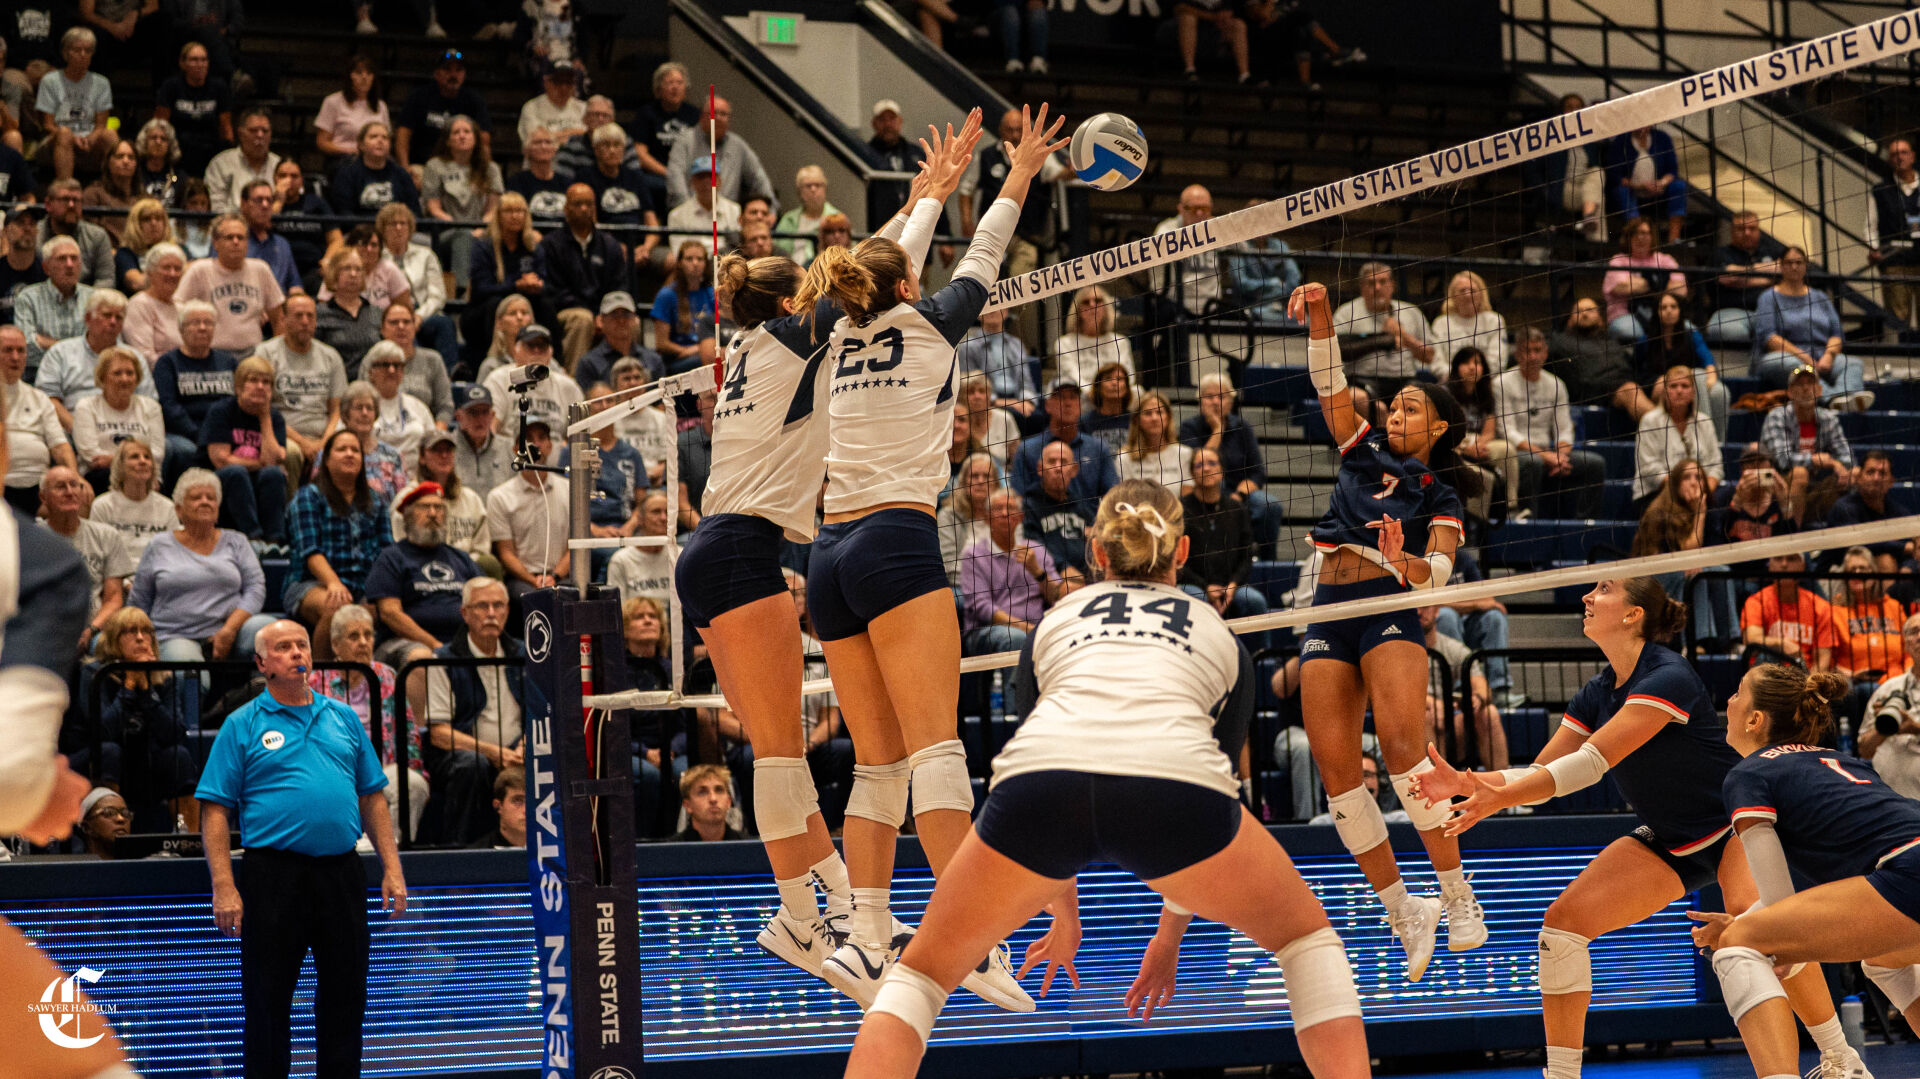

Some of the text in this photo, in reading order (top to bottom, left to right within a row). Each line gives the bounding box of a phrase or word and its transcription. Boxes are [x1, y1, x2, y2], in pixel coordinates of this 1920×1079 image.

[1680, 60, 1759, 107] PENN
[1768, 31, 1860, 81] STATE
[1285, 111, 1593, 221] PENN STATE VOLLEYBALL
[988, 220, 1217, 307] ENN STATE VOLLEYBALL
[724, 350, 750, 402] 4
[835, 326, 905, 380] 23
[1371, 472, 1400, 501] 7
[1078, 592, 1194, 640] 44
[1818, 757, 1873, 785] 1
[532, 717, 564, 913] STATE
[596, 902, 621, 1045] PENN STATE
